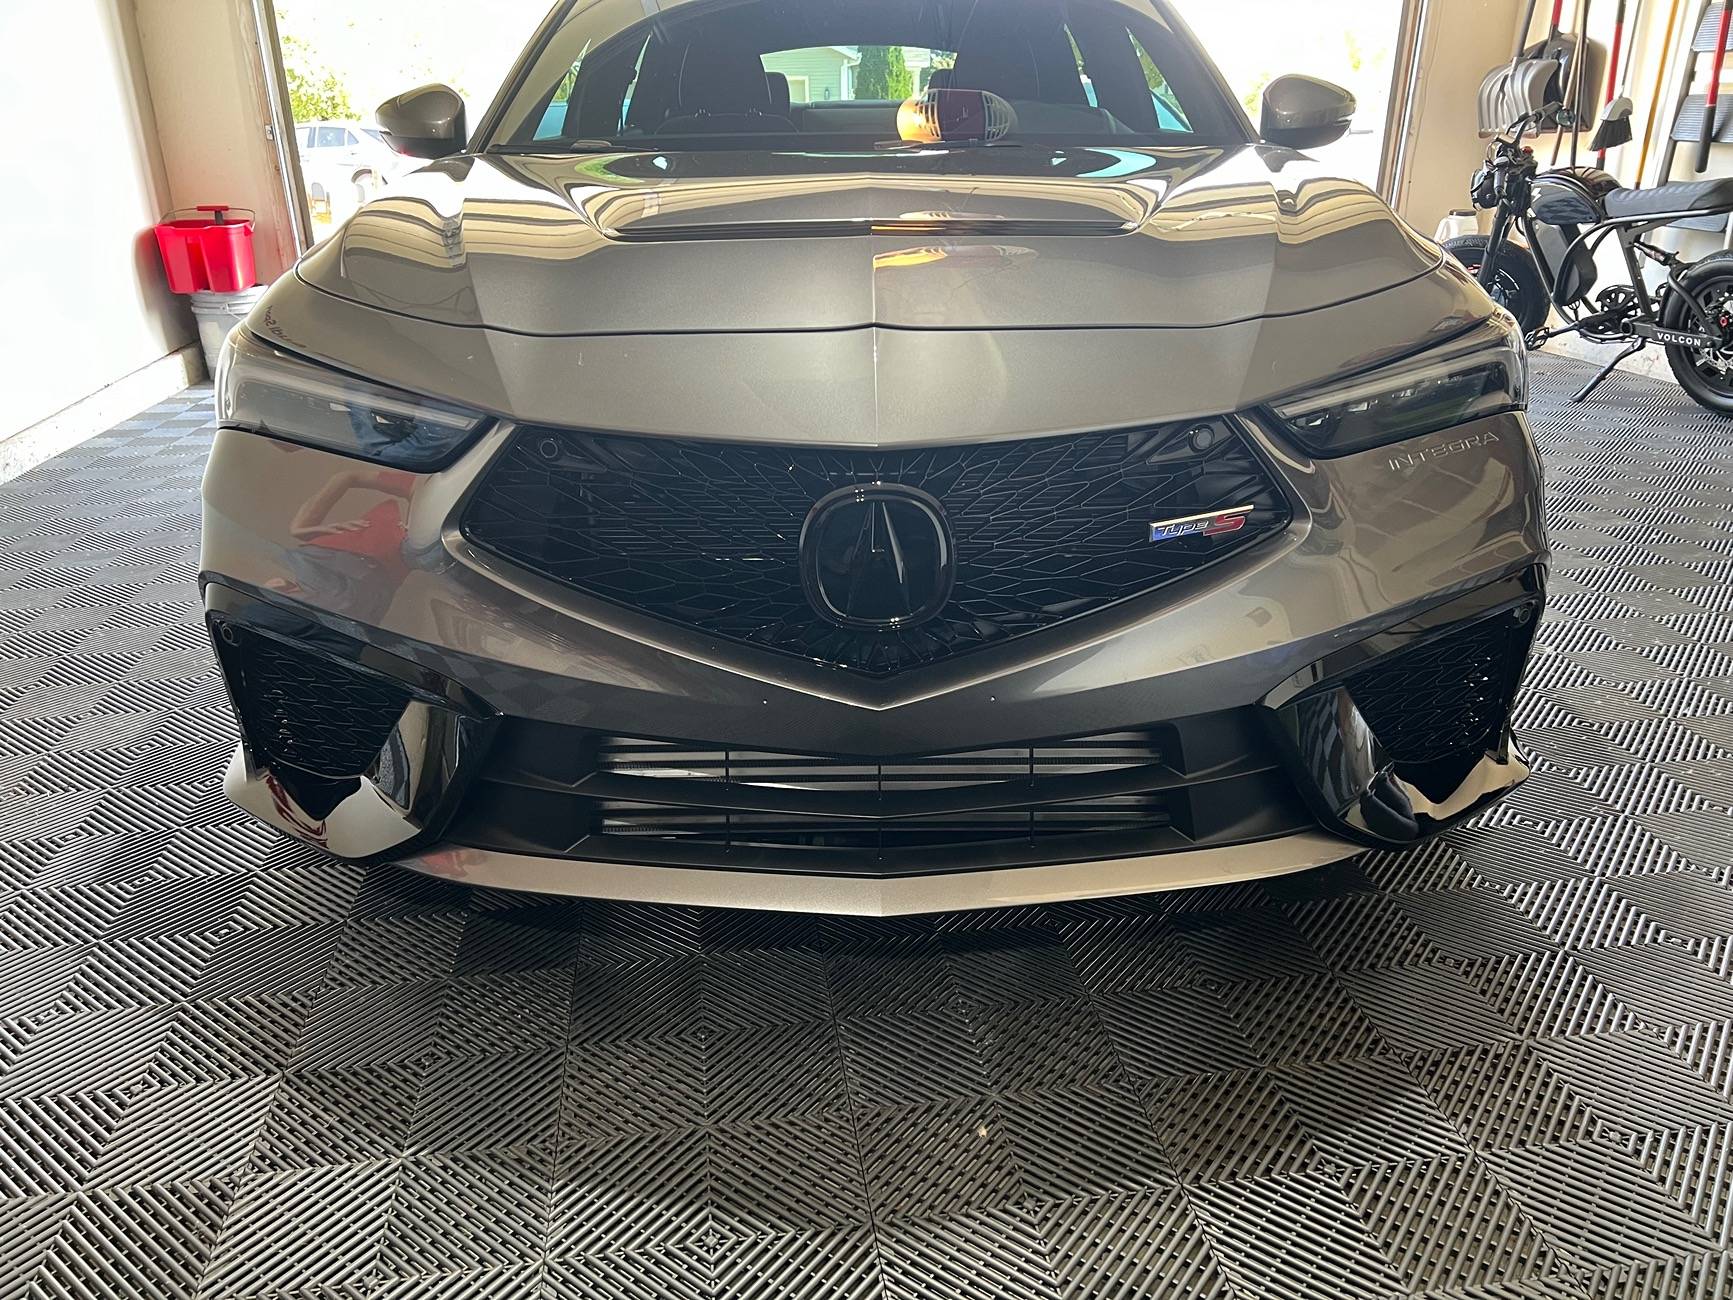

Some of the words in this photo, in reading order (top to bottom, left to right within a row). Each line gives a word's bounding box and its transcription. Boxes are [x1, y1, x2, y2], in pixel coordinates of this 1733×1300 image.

[1657, 332, 1701, 347] VOLCON
[1388, 431, 1500, 471] INTEGRA
[1158, 520, 1209, 536] Type
[1203, 509, 1251, 537] S
